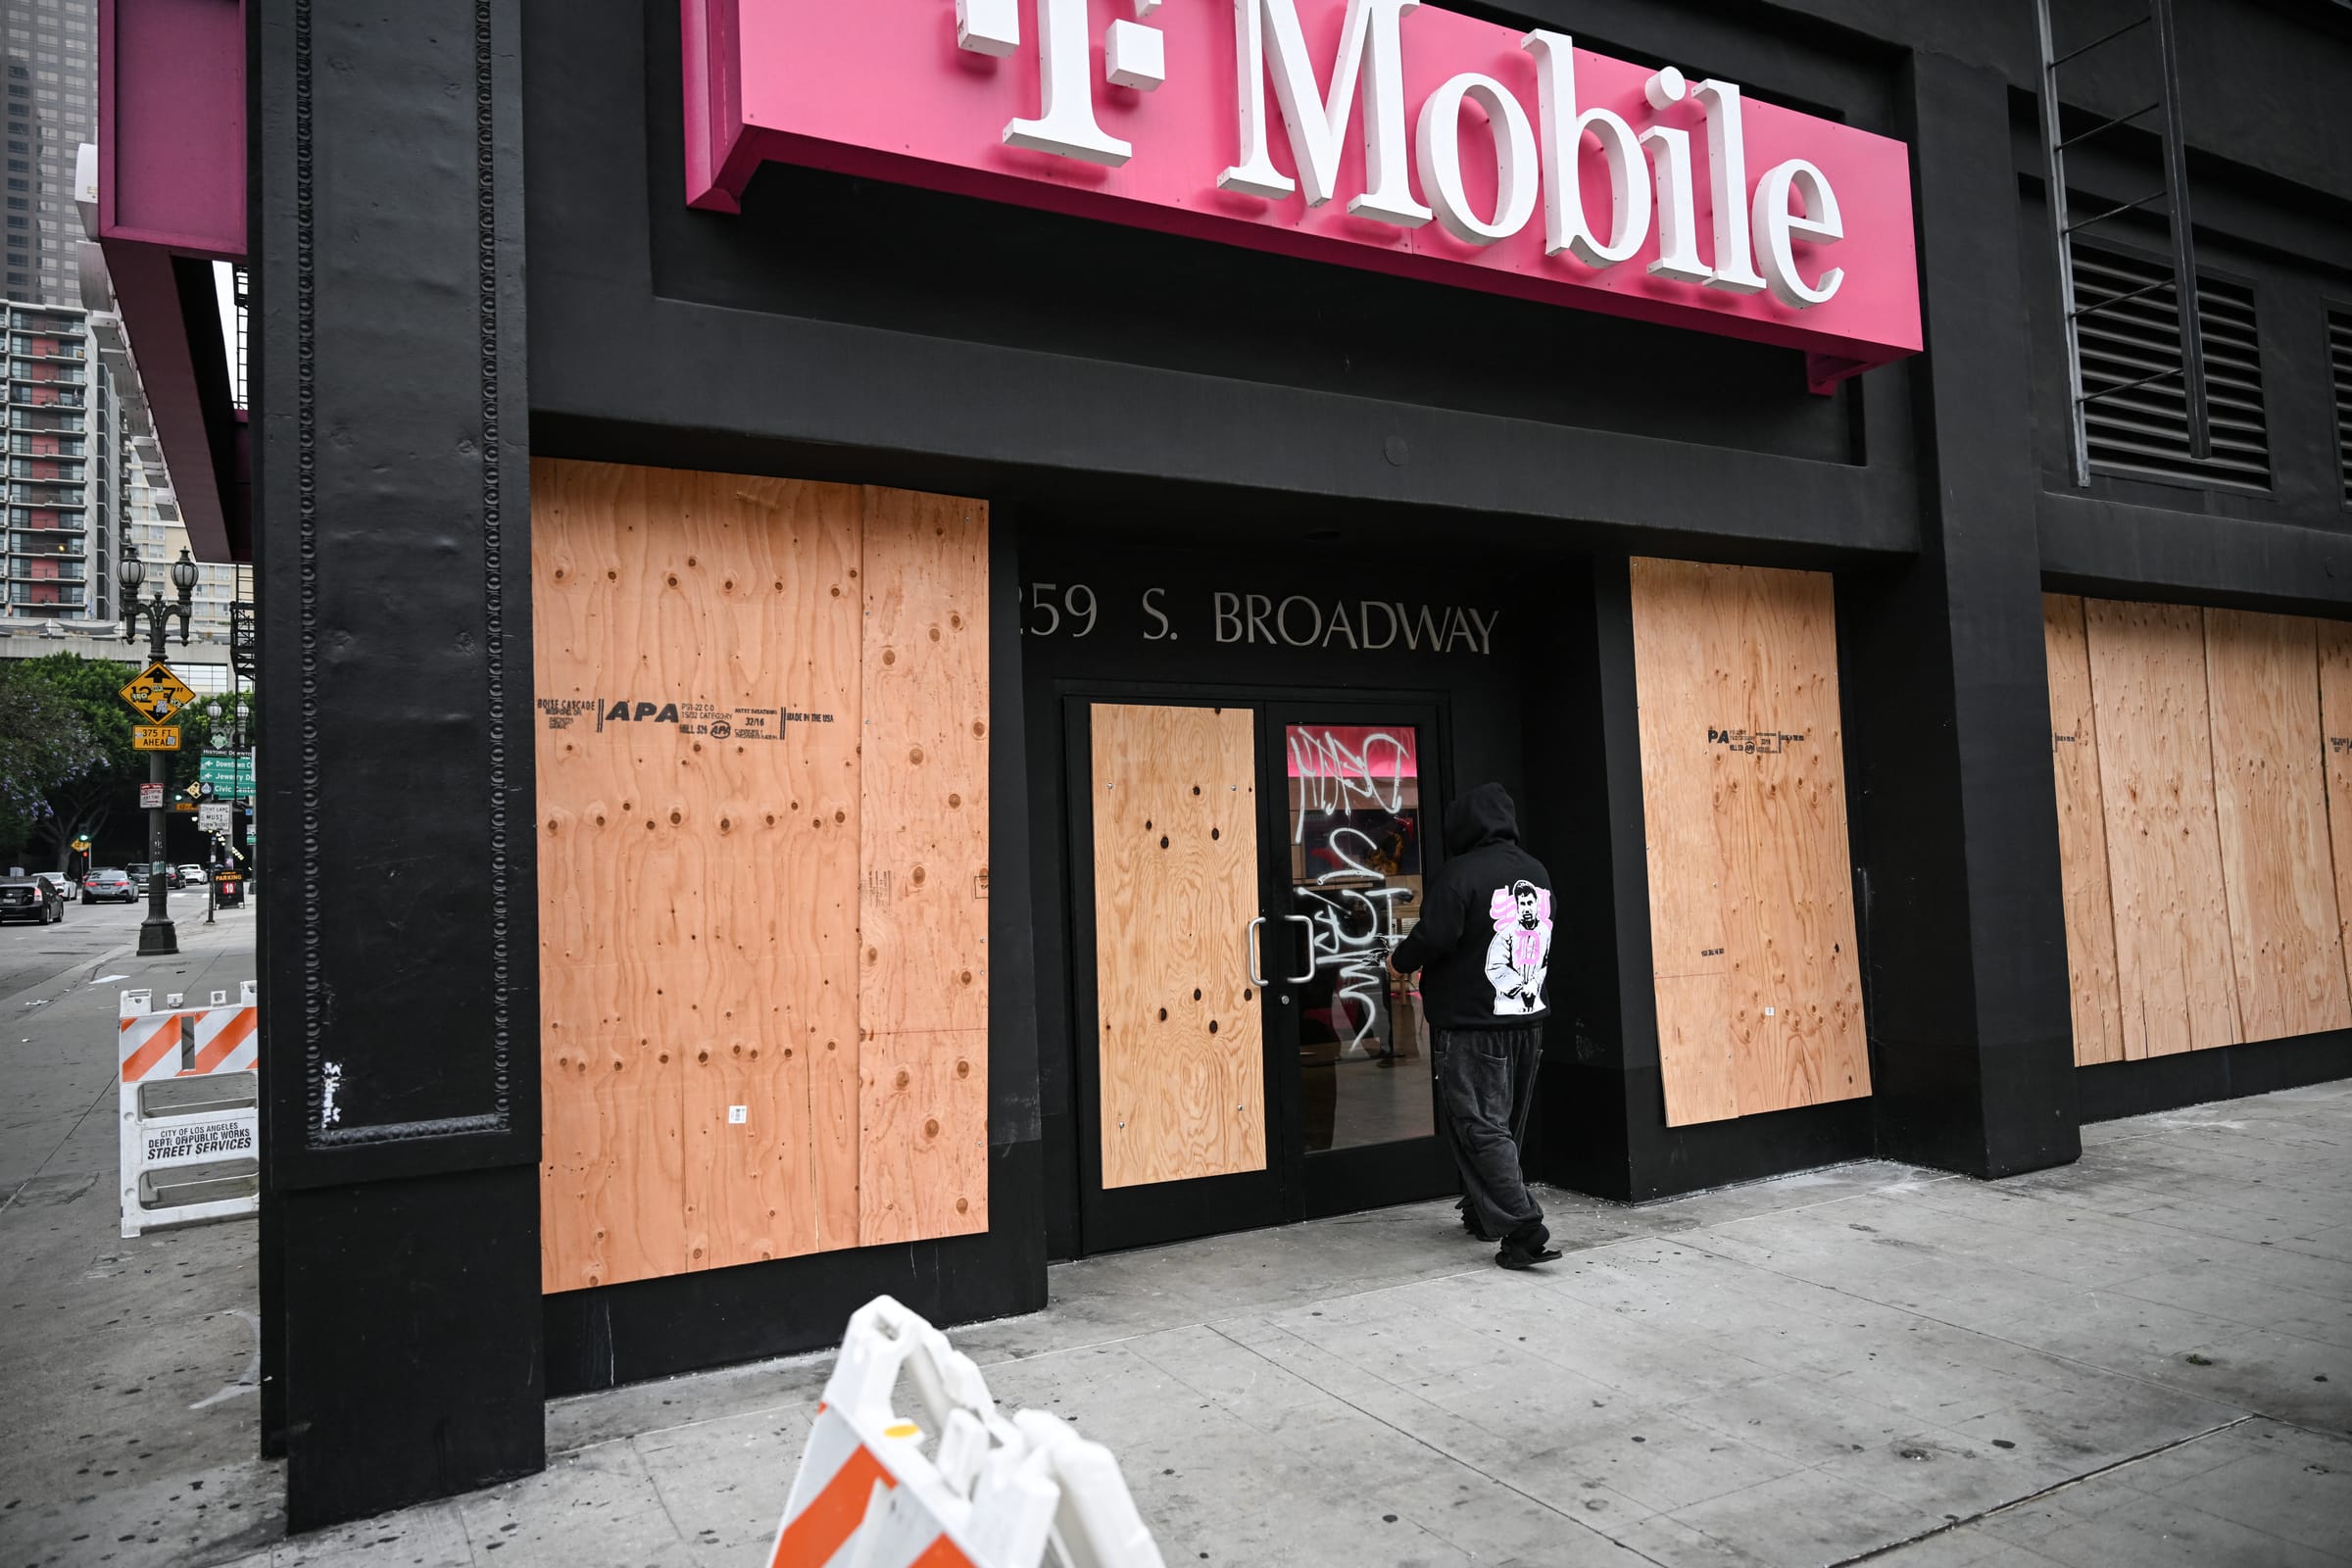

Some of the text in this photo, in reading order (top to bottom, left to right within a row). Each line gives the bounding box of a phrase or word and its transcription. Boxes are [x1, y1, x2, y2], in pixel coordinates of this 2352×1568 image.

[1019, 582, 1500, 655] 59 S. BROADWAY
[562, 700, 596, 710] CASCADE
[605, 700, 679, 723] APA
[160, 1129, 176, 1138] CITY
[190, 1126, 205, 1135] LOS
[206, 1122, 238, 1133] ANGELES
[188, 1132, 219, 1144] PUBLIC
[220, 1128, 250, 1140] WORKS
[147, 1137, 252, 1160] STREET SERVICES
